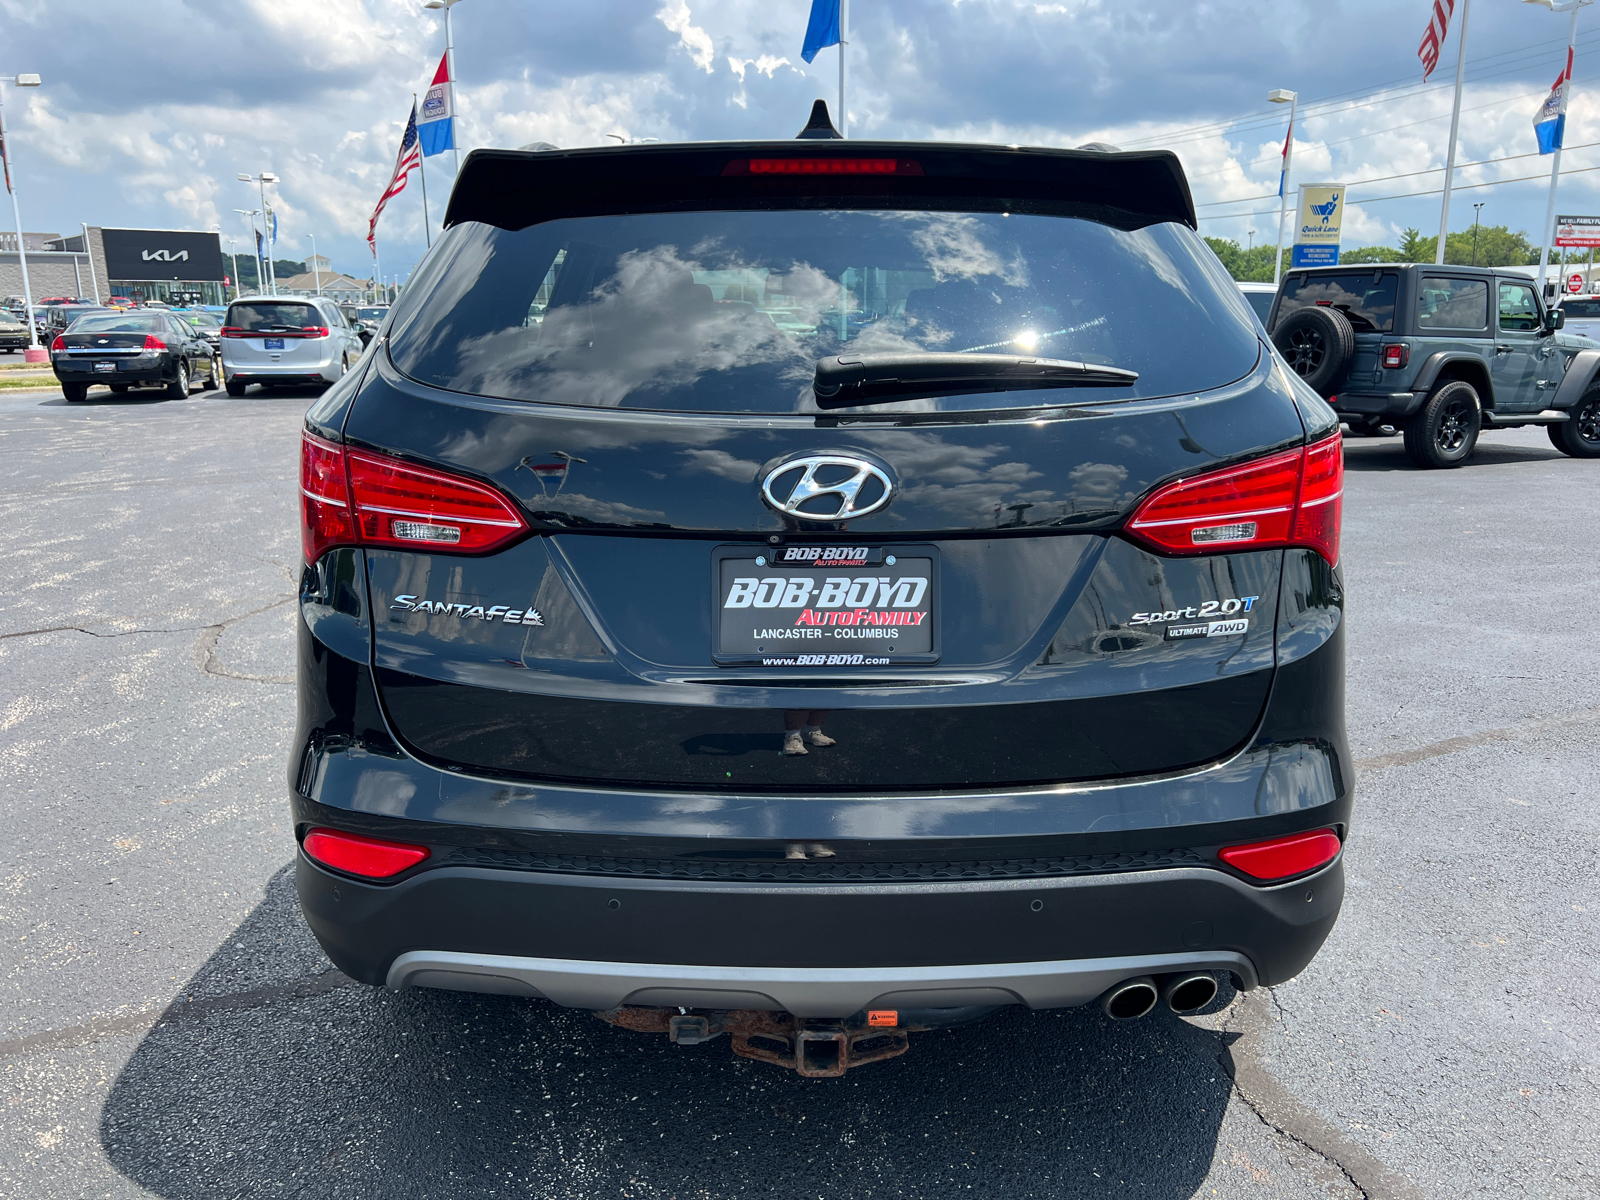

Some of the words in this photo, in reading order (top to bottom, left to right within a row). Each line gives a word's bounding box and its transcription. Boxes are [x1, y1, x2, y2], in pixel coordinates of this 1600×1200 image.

[1302, 225, 1323, 233] Quick
[142, 249, 189, 262] KIA
[784, 547, 869, 561] BOB-BOYD
[723, 577, 928, 609] BOB-BOYD
[1128, 606, 1198, 626] Sport
[753, 628, 822, 639] LANCASTER
[834, 628, 899, 639] COLUMBUS
[1169, 627, 1208, 637] ULTIMATE
[1211, 622, 1246, 634] AWD
[762, 654, 890, 666] www.BOB-BOYD.com
